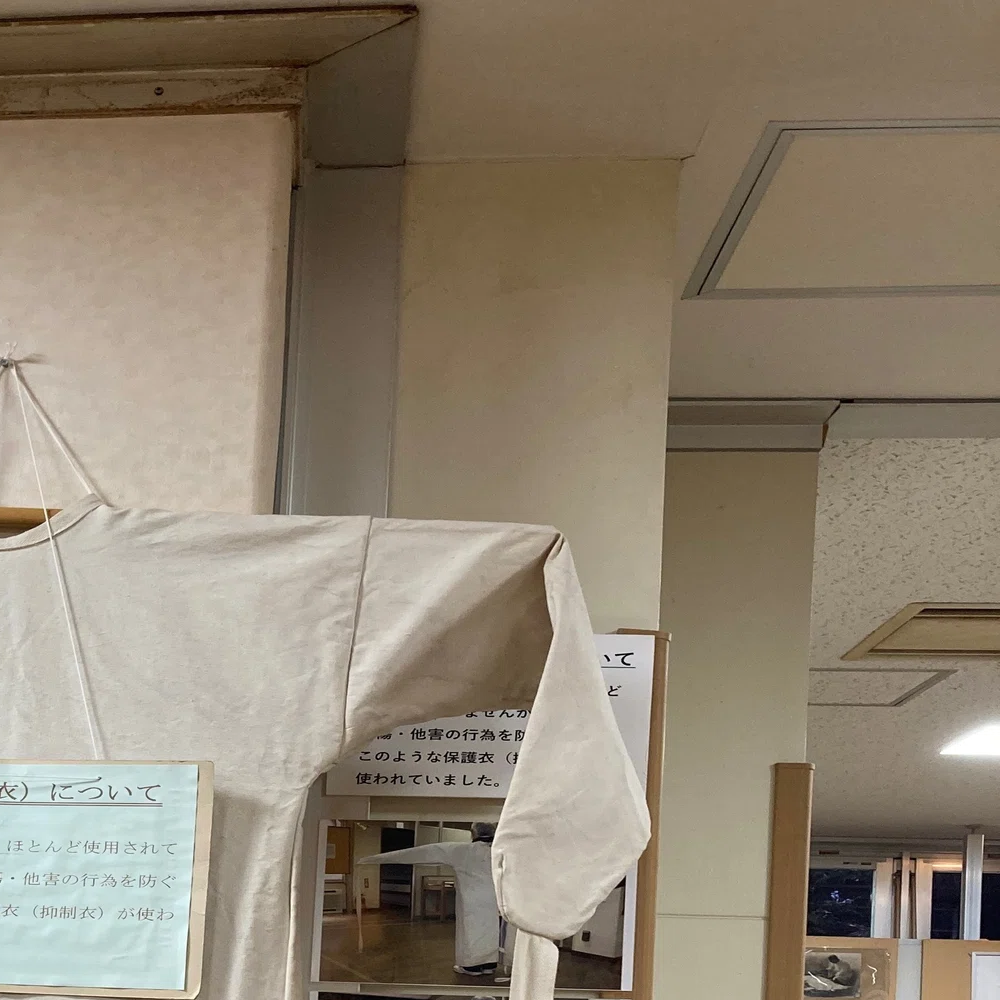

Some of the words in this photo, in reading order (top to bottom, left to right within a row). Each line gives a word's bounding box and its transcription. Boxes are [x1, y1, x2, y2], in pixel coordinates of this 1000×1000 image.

[607, 685, 622, 697] ど
[355, 772, 500, 788] 使われていました。
